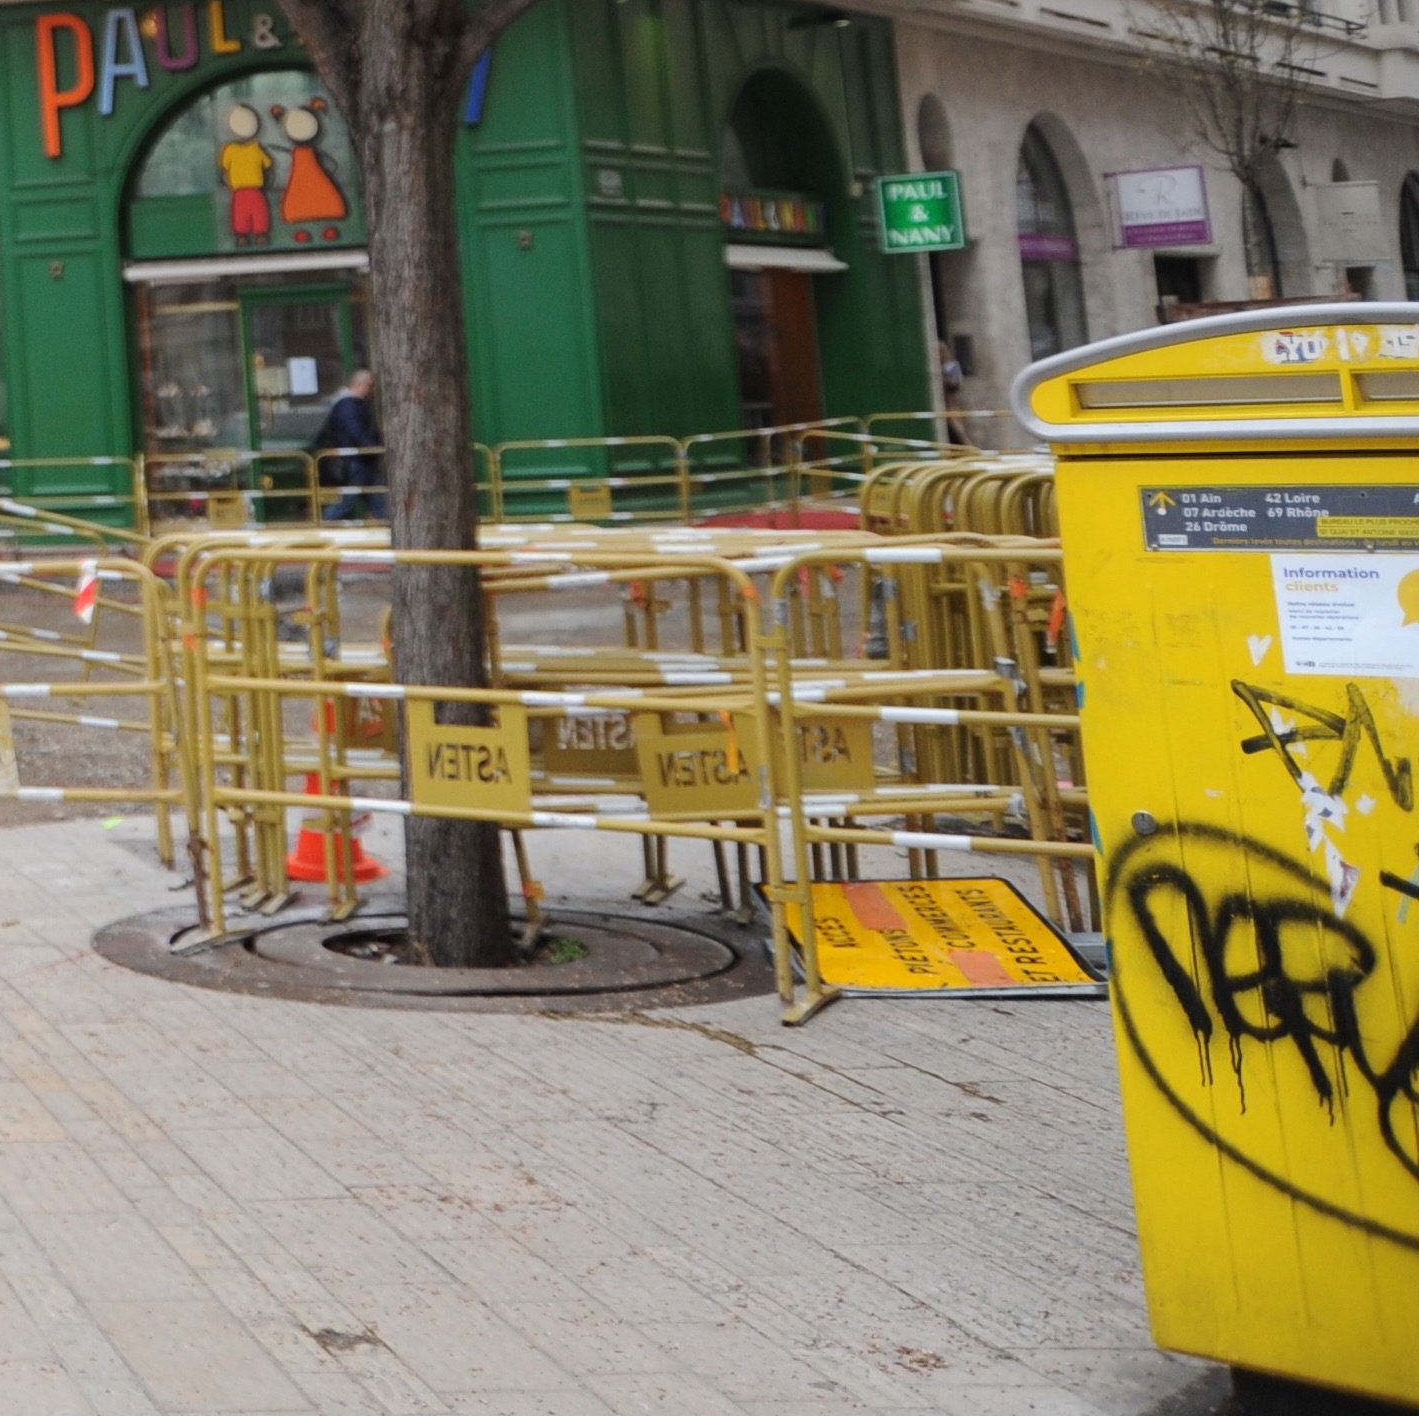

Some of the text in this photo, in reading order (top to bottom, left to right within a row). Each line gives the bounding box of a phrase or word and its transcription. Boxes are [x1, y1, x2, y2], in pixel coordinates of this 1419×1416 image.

[35, 0, 284, 160] PAUL &
[888, 180, 948, 202] PAUL
[910, 205, 929, 223] &
[888, 225, 957, 245] NANY
[1182, 492, 1320, 504] 01 Ain 42 Loire
[1184, 506, 1330, 518] 07 Ardèche 69 Rhône
[1185, 521, 1248, 533] 26 Drôme
[1283, 567, 1380, 580] Information
[1286, 580, 1339, 593] clients
[898, 884, 977, 952] COMMERCES
[955, 888, 1069, 984] ET RESTAURANTS
